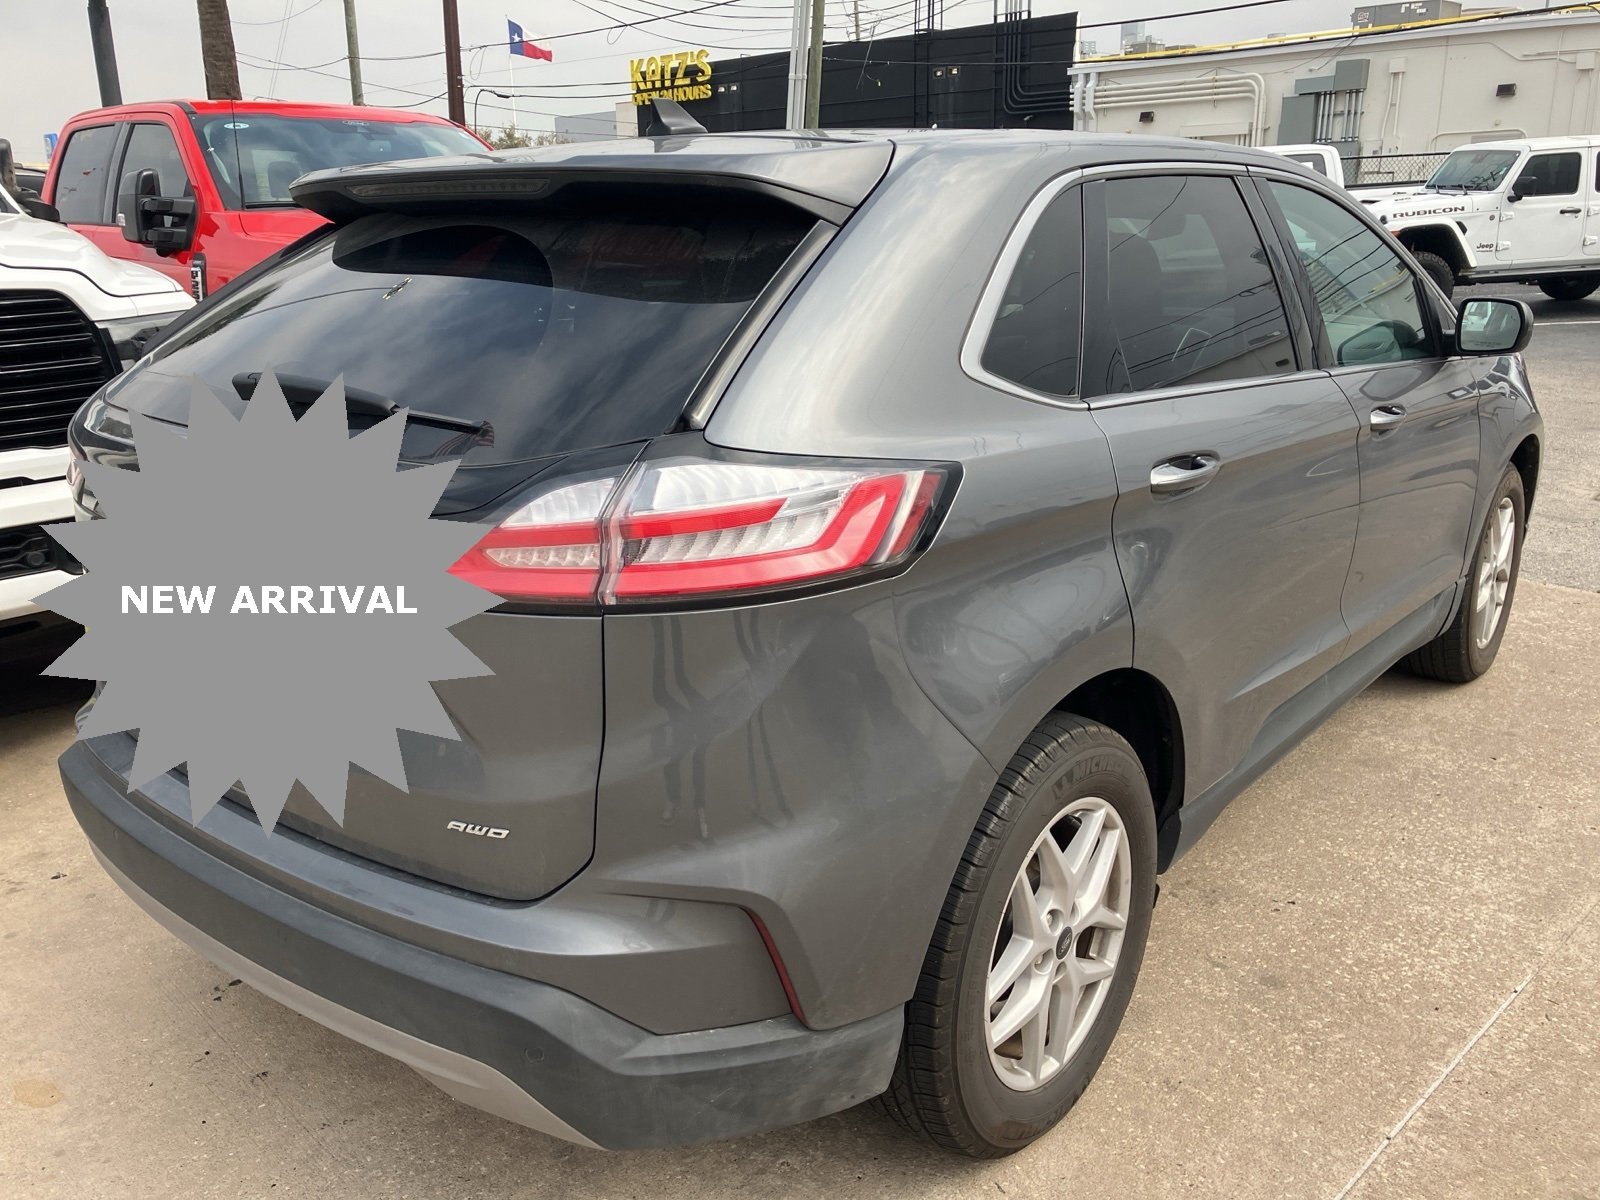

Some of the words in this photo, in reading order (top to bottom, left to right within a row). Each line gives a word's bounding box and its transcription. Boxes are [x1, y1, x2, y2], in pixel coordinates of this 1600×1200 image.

[630, 49, 712, 90] KATZ'S
[632, 90, 659, 106] OPEN
[673, 84, 712, 102] HOURS
[1392, 206, 1465, 219] RUBICON
[1476, 242, 1494, 250] Jeep
[446, 820, 510, 839] AWD
